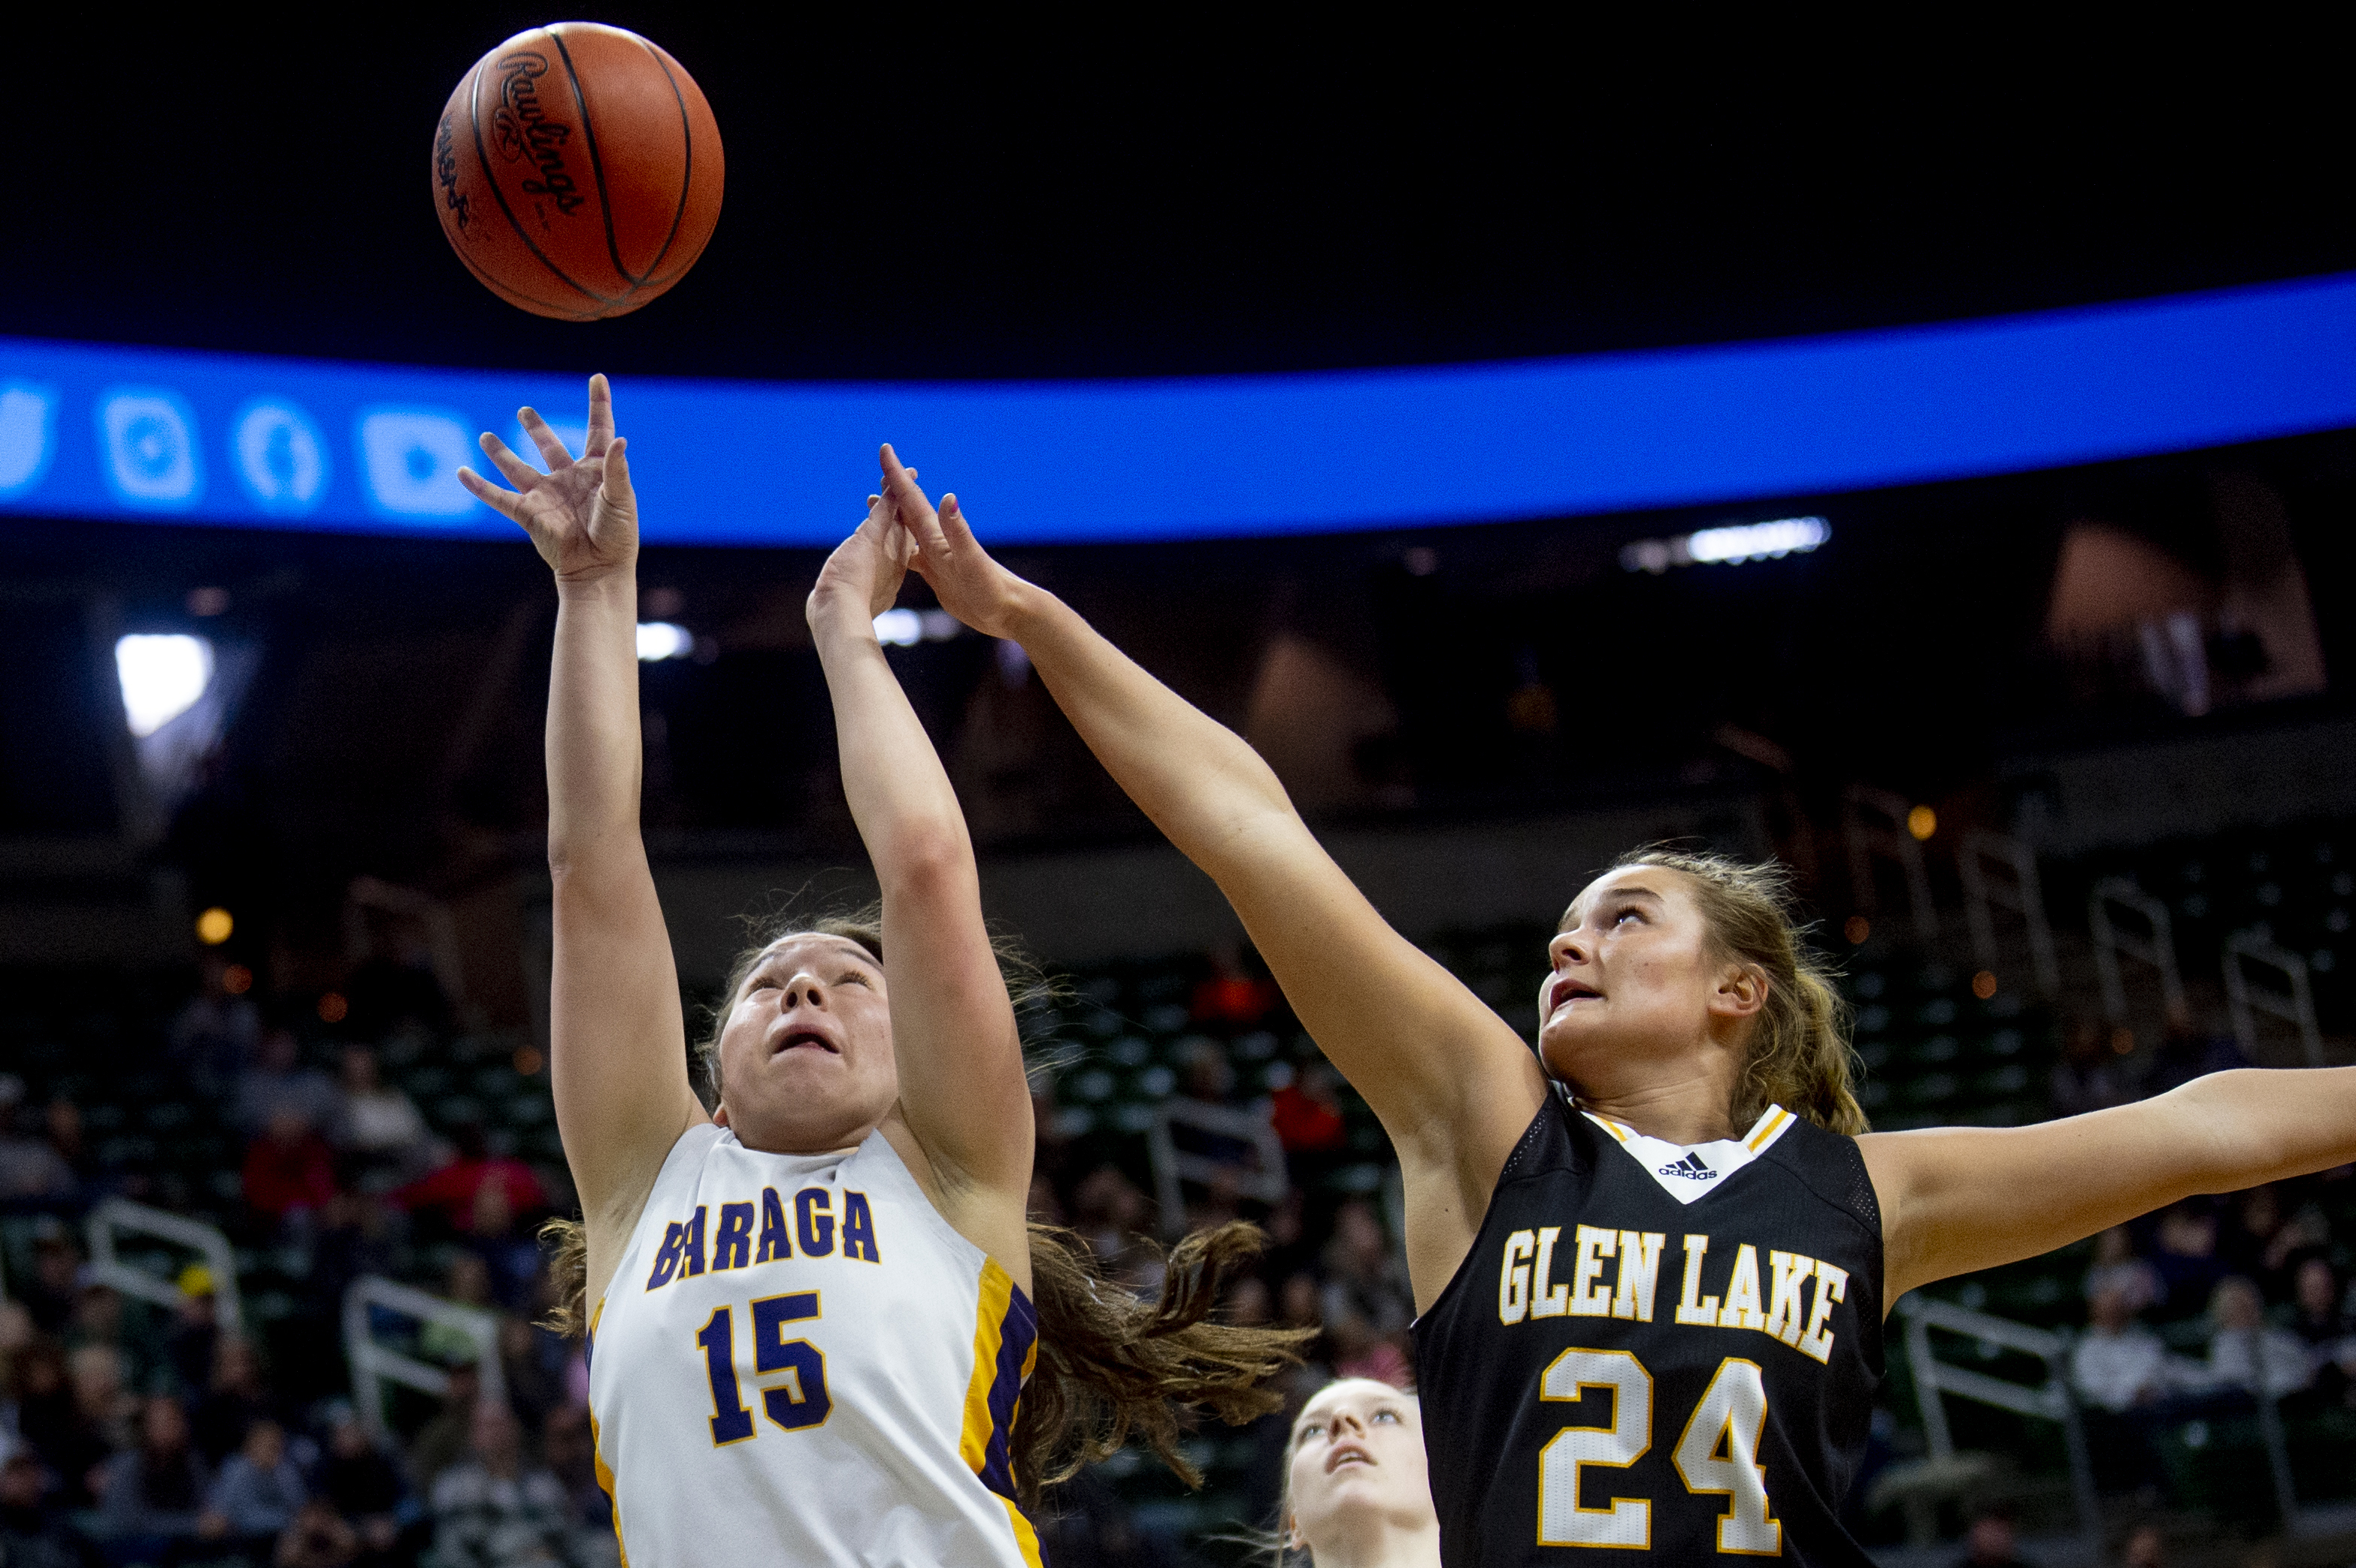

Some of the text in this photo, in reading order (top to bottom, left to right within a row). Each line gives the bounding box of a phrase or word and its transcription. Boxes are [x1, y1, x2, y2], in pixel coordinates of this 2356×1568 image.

[498, 51, 585, 216] Rawlings
[644, 1185, 882, 1294] BARAGA
[1658, 1168, 1718, 1180] adidas
[695, 1289, 834, 1448] 15
[1498, 1224, 1849, 1364] GLEN LAKE
[1537, 1347, 1782, 1557] 24
